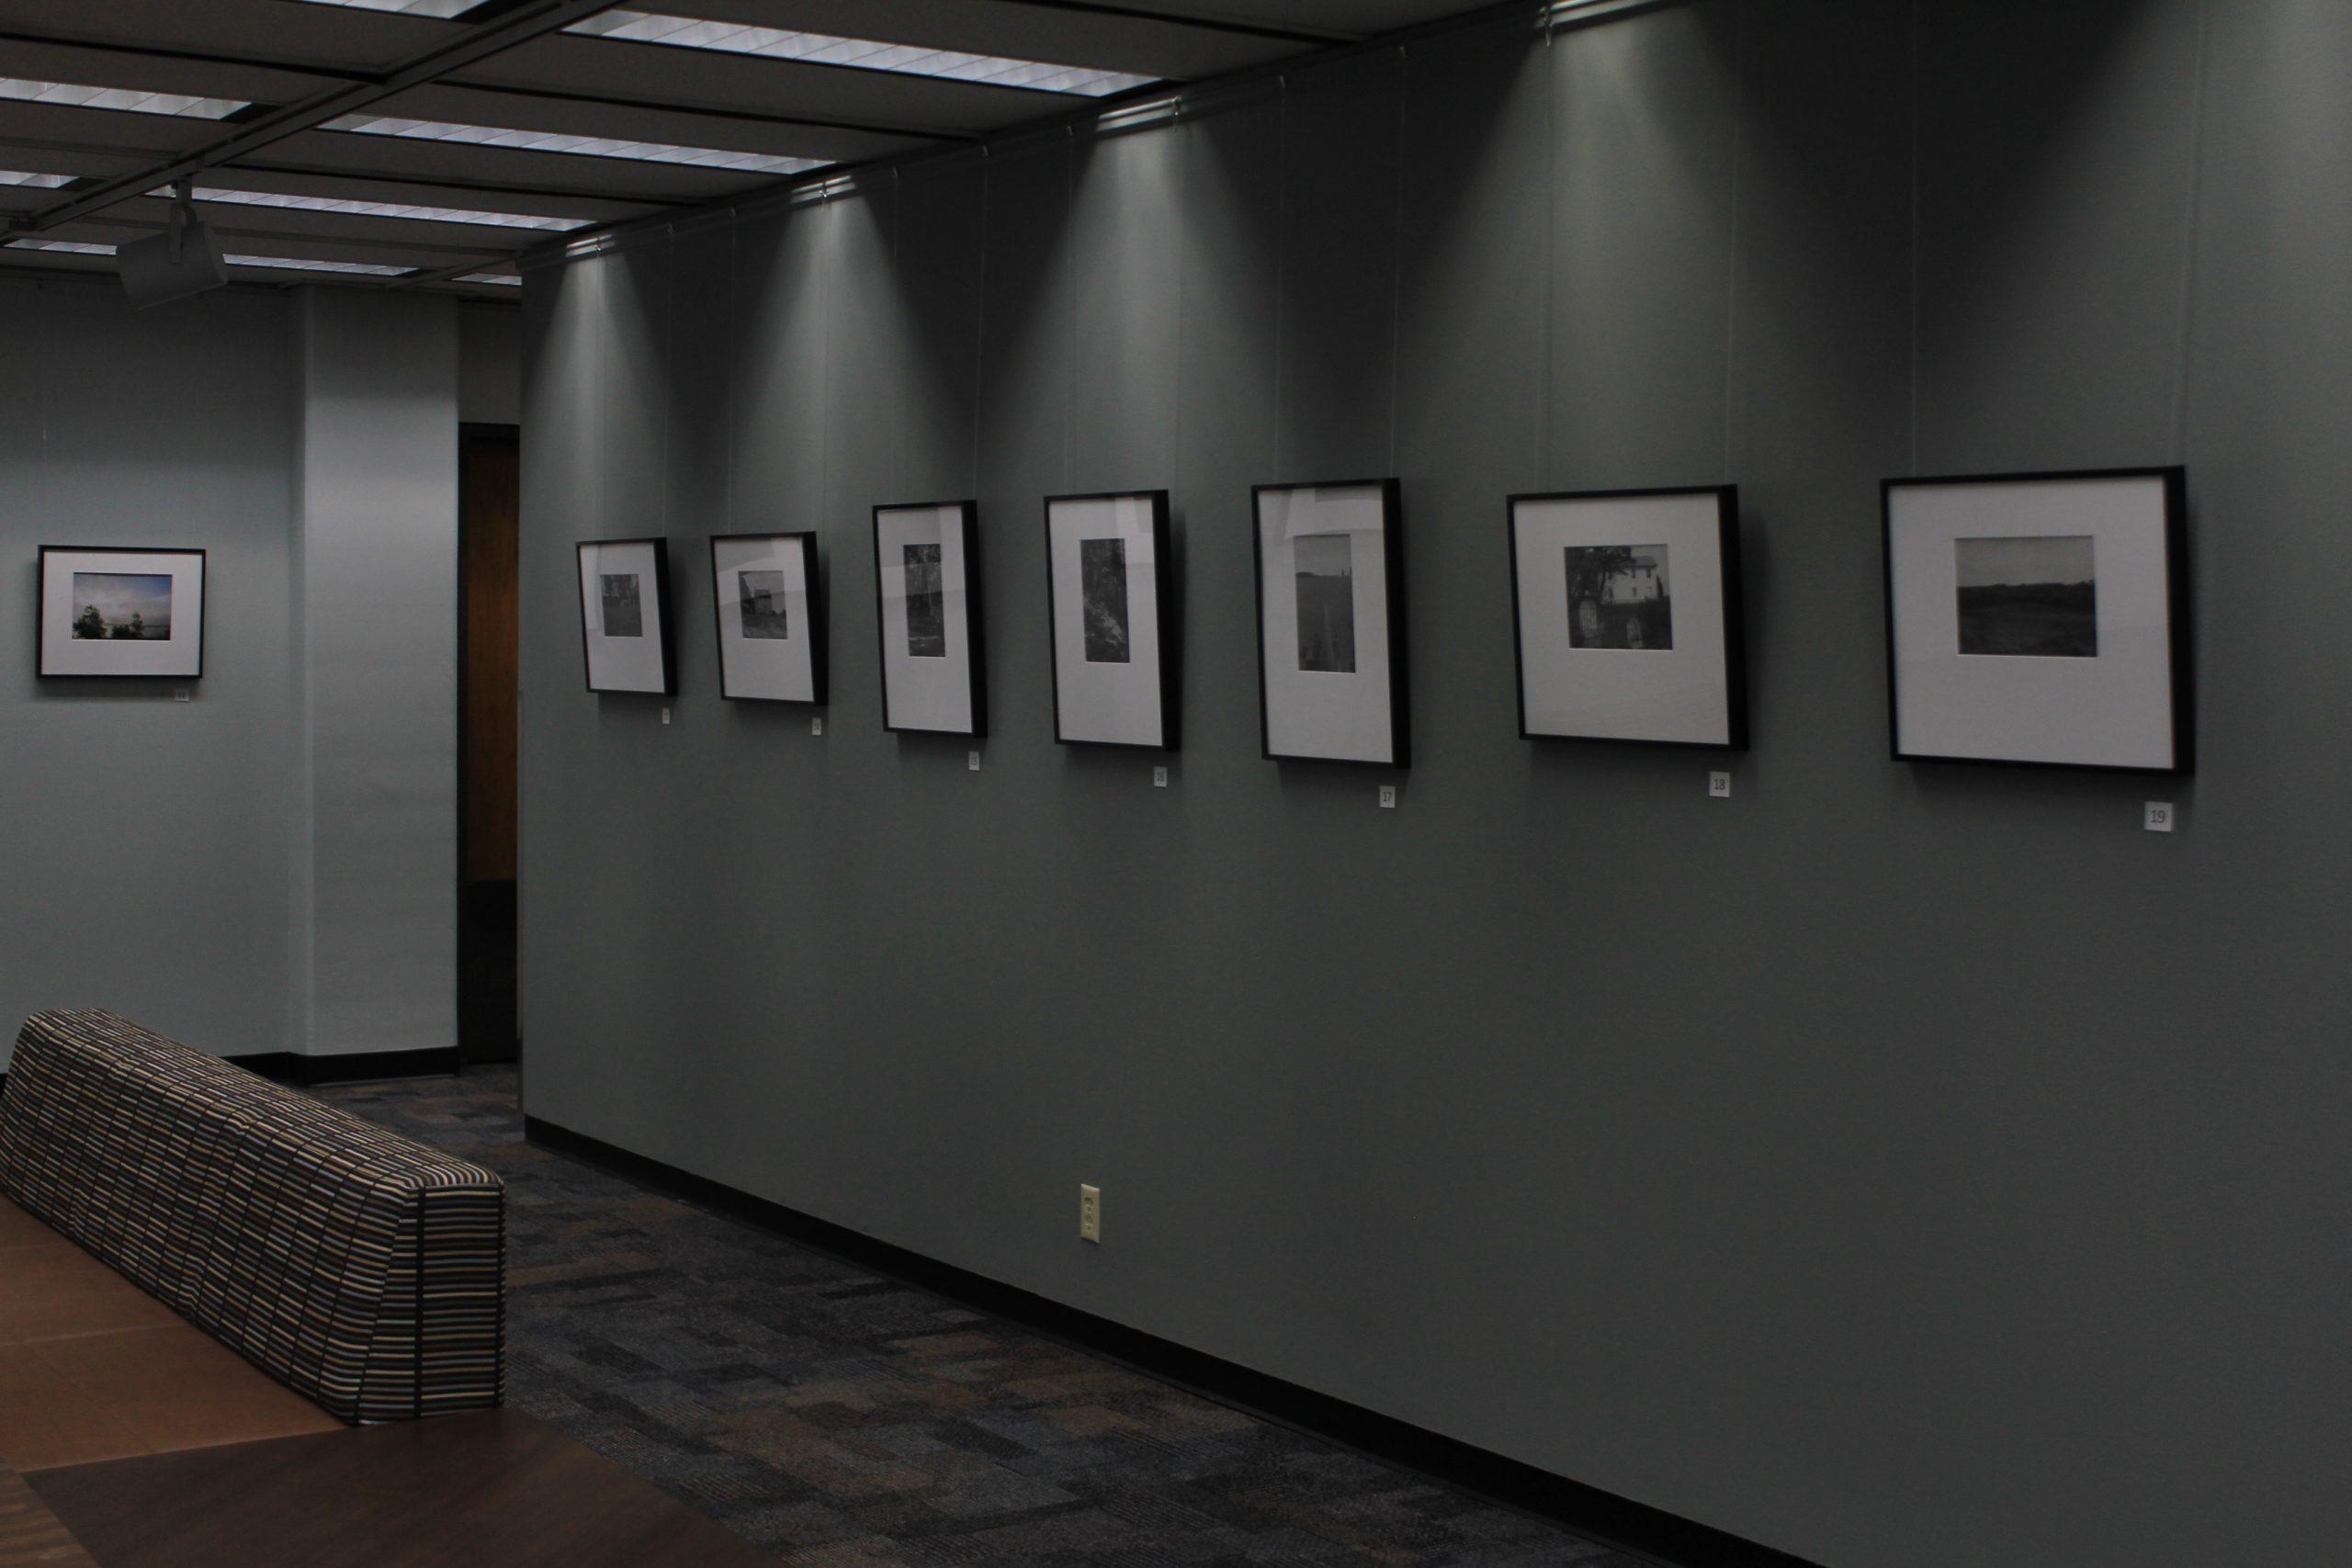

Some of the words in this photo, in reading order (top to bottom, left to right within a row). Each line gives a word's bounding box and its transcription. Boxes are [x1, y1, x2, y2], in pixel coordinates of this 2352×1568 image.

[1713, 779, 1726, 790] 18
[1383, 792, 1392, 802] 17
[2150, 810, 2165, 823] 19
